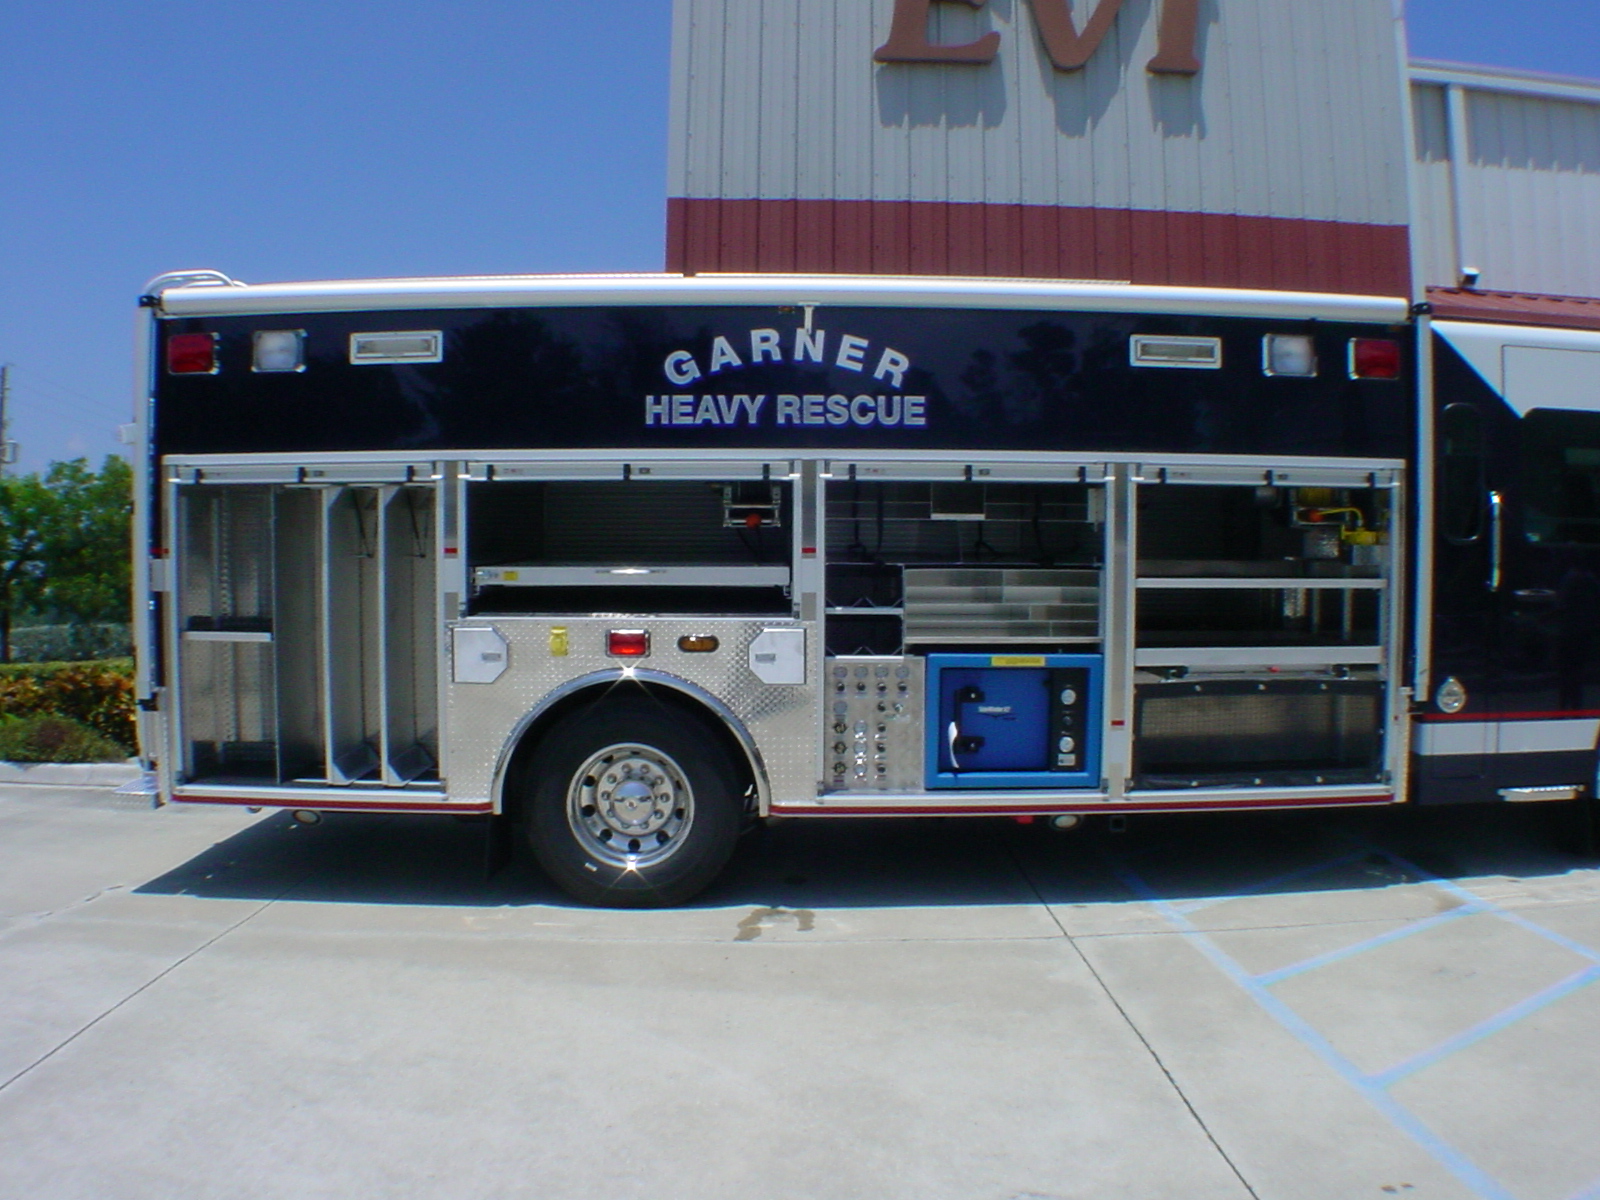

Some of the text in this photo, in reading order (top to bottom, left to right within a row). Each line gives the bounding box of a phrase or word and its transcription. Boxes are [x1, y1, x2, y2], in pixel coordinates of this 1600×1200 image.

[664, 327, 910, 388] GARNER
[645, 394, 927, 426] HEAVY RESCUE
